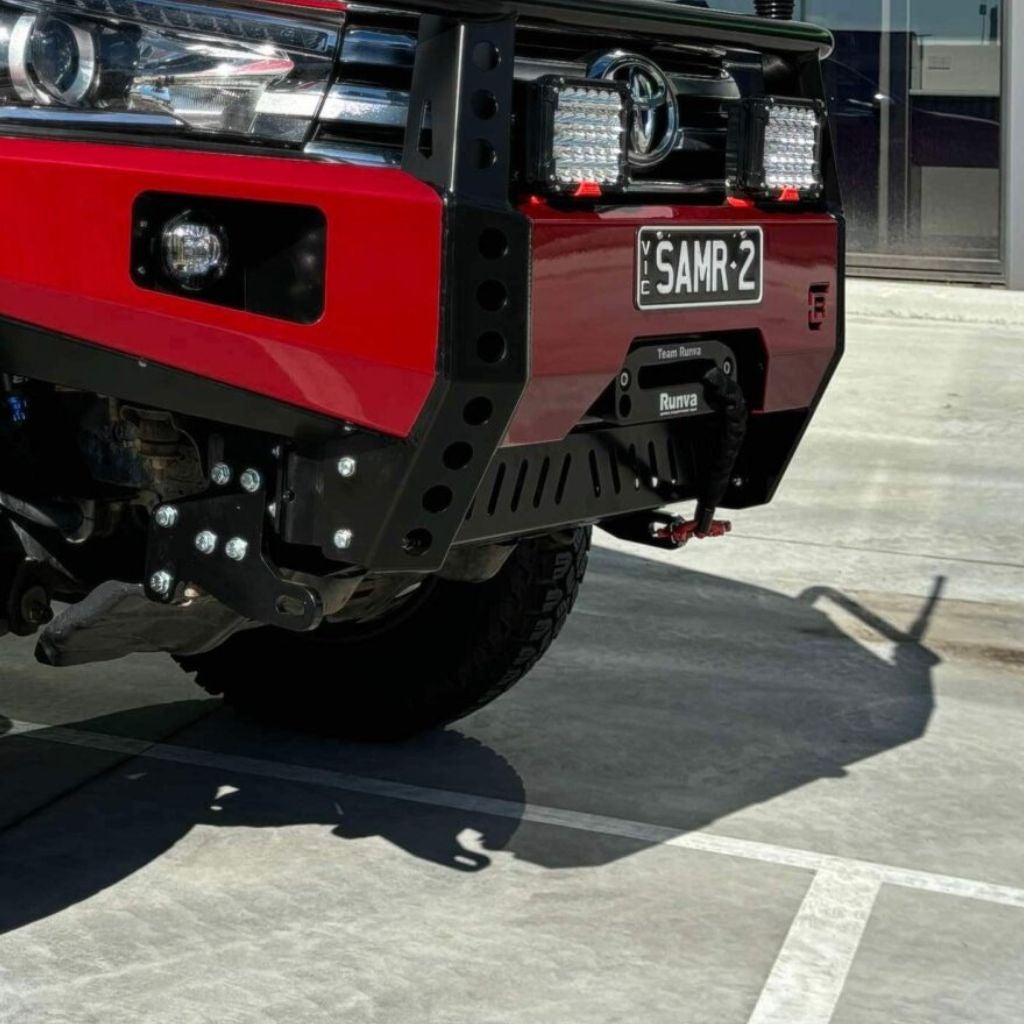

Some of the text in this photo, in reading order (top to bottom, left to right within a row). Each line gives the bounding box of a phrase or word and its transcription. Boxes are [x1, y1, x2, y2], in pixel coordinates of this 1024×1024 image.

[657, 346, 702, 360] Team Runva
[659, 392, 698, 411] Runva
